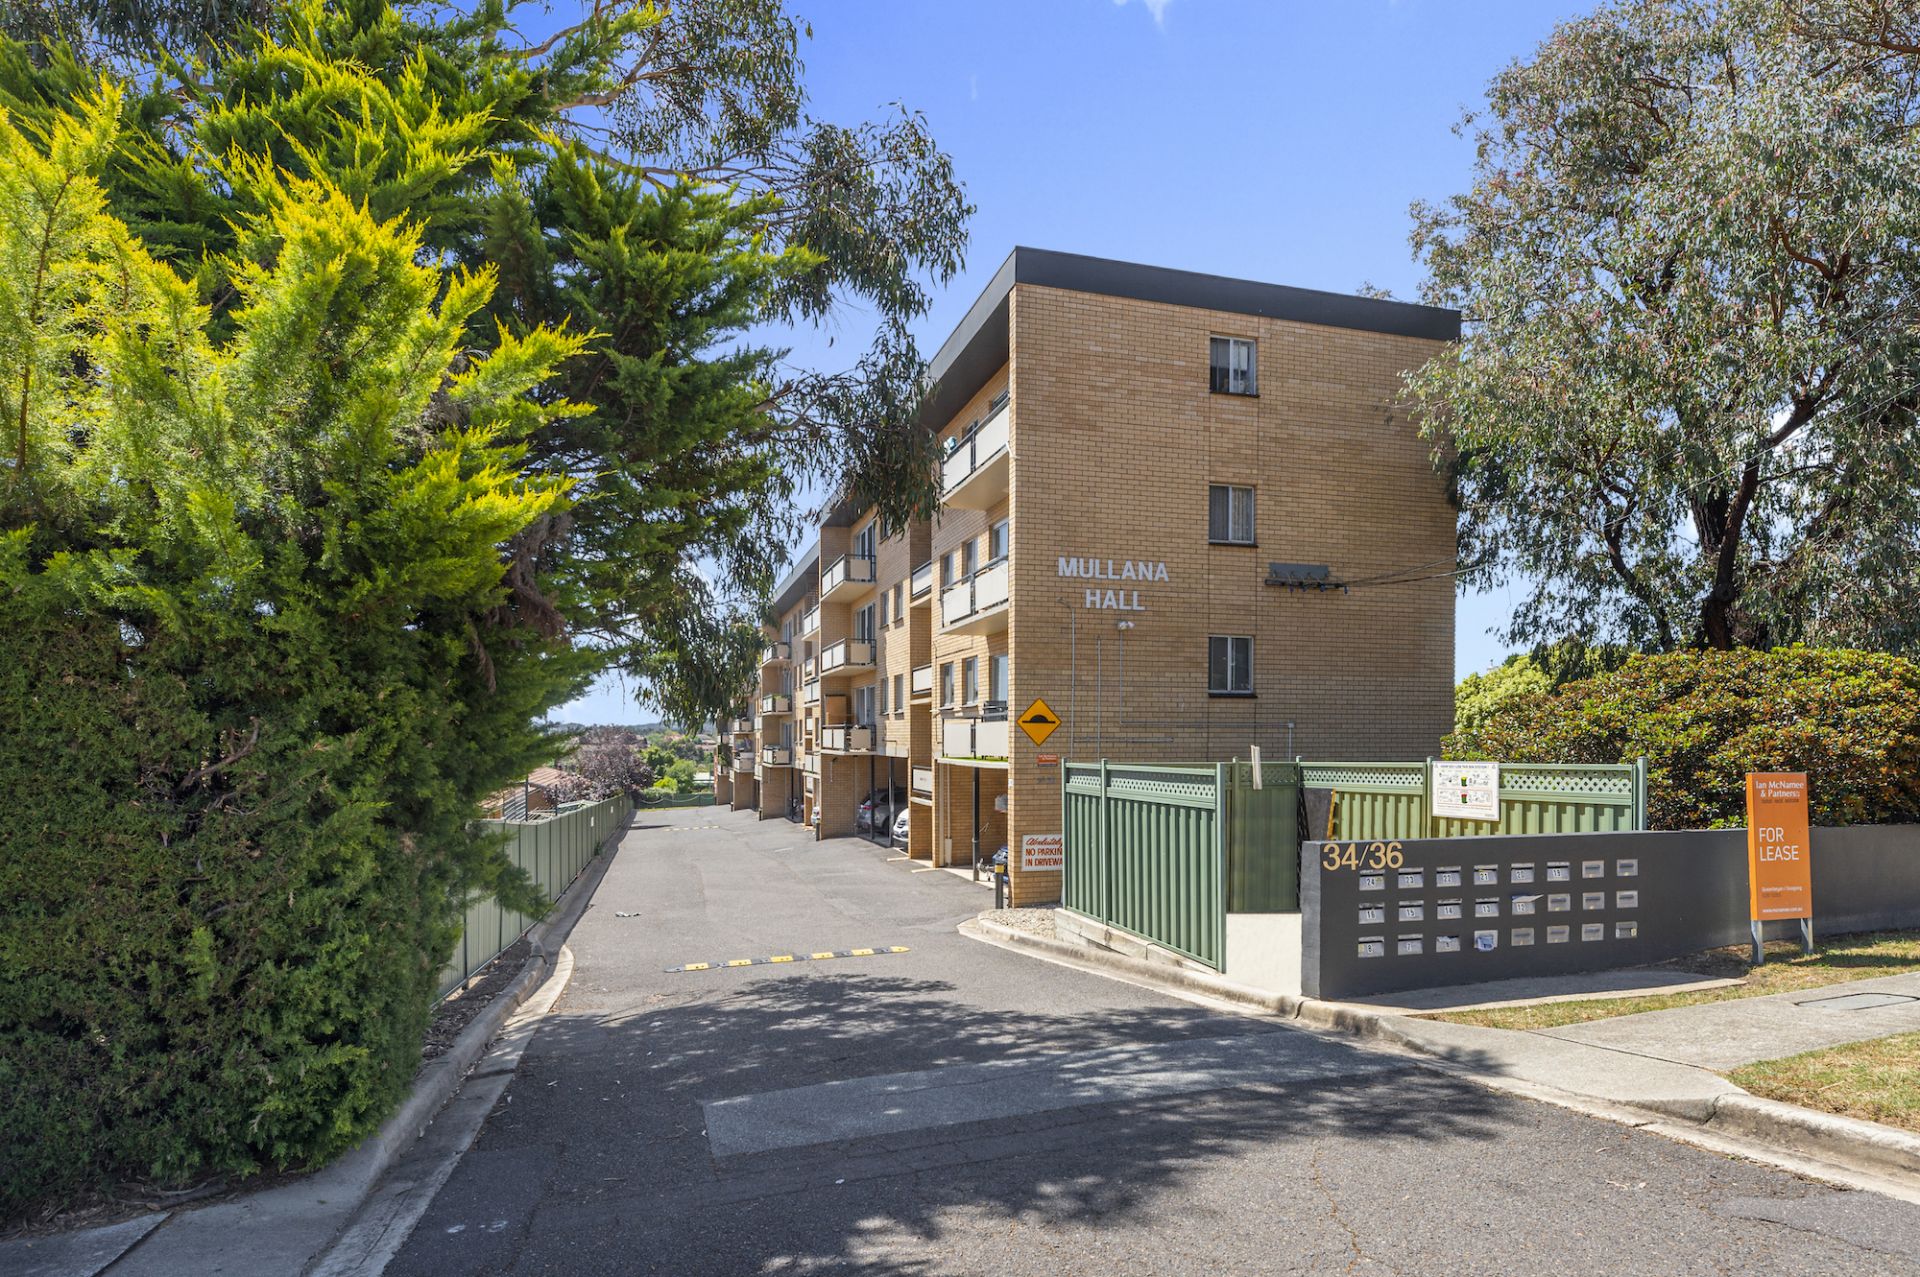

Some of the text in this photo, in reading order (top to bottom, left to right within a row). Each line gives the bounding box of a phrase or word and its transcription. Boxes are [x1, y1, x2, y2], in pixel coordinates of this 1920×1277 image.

[1058, 556, 1169, 582] MULLANA
[1085, 588, 1146, 611] HALL
[1755, 780, 1804, 789] Ian McNamee
[1760, 789, 1796, 798] & Partners
[1759, 827, 1785, 842] FOR
[1025, 848, 1063, 856] NO PARKIN
[1322, 841, 1404, 871] 34/36
[1759, 845, 1800, 862] LEASE
[1025, 858, 1033, 867] IN
[1480, 873, 1488, 881] 21
[1553, 869, 1561, 877] 19
[1366, 878, 1375, 886] 24
[1406, 876, 1414, 884] 23
[1406, 908, 1415, 916] 15
[1445, 906, 1453, 914] 14
[1482, 904, 1491, 913] 13
[1367, 910, 1375, 919] 16
